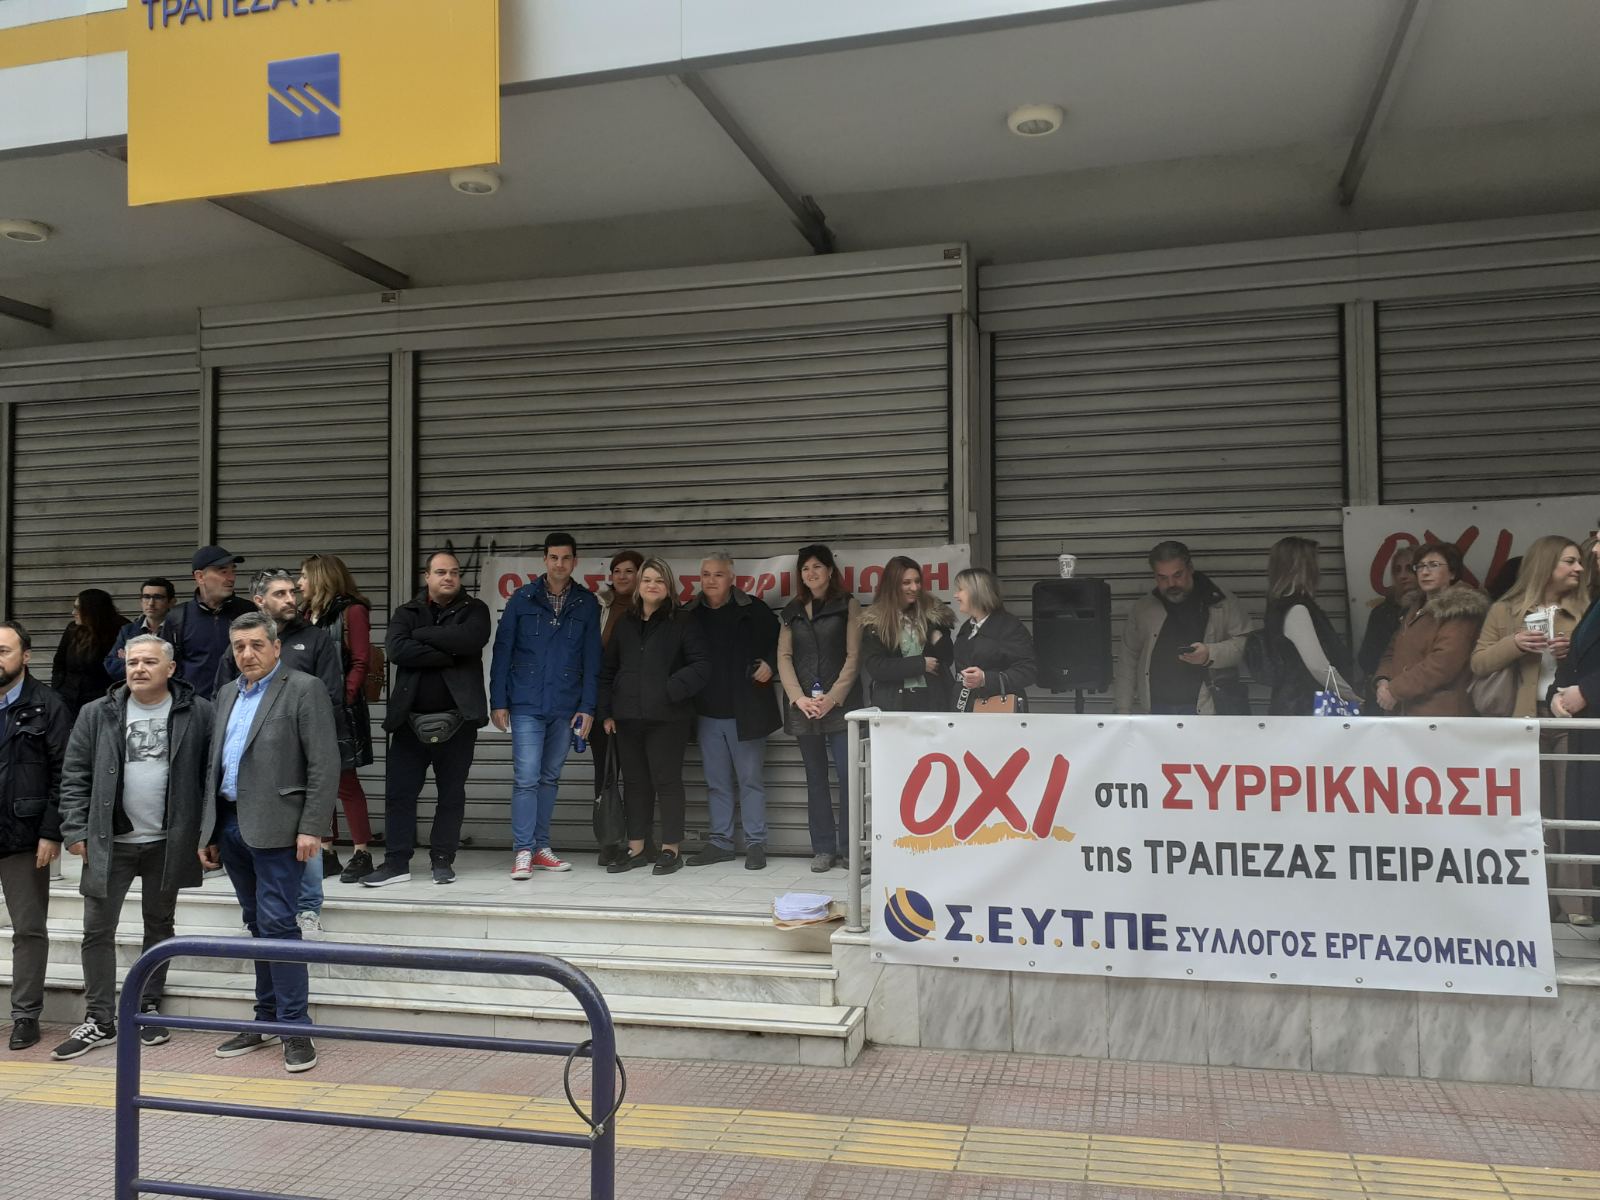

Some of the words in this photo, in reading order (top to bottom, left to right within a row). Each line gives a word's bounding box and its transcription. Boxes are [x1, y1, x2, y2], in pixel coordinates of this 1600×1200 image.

[141, 0, 299, 30] ΤΡΑΠΕ
[899, 747, 1070, 841] ΟΧΙ
[1094, 781, 1149, 809] στη
[1161, 763, 1522, 816] ΣΥΡΡΙΚΝΩΣΗ
[1143, 840, 1337, 879] ΤΡΑΠΕΖΑΣ
[1349, 845, 1531, 885] ΠΕΙΡΑΙΩΣ
[944, 904, 1169, 951] Σ.Ε.Υ.Τ.ΠΕ
[1175, 926, 1318, 958] ΣΥΛΛΟΓΟΣ
[1325, 932, 1538, 968] ΕΡΓΑΖΟΜΕΝΩΝ
